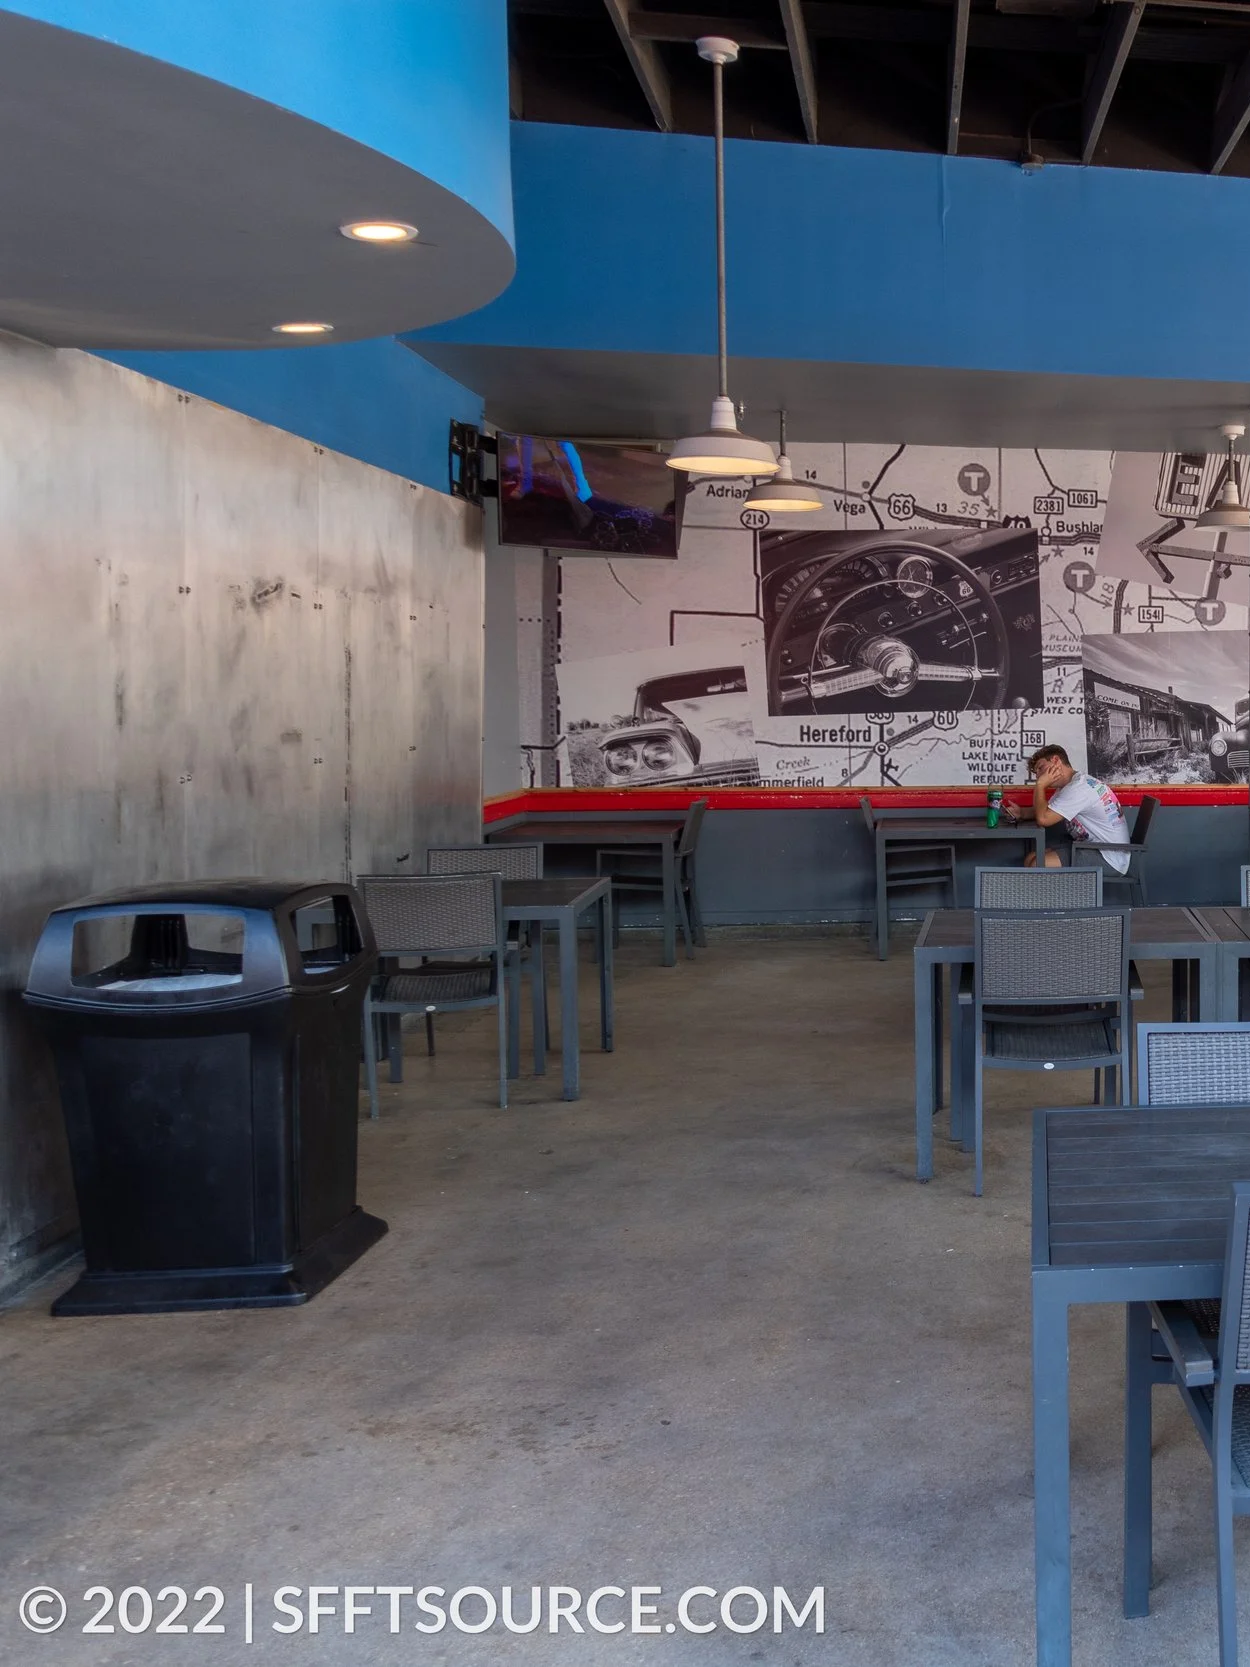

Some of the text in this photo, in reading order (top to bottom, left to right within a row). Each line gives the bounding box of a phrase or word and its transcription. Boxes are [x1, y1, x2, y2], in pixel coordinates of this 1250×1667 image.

[805, 470, 817, 480] 14
[964, 472, 984, 492] T
[1072, 493, 1094, 504] 1061
[834, 500, 866, 515] Vega
[893, 500, 910, 515] 66
[936, 503, 948, 513] 13
[957, 501, 980, 516] 35
[1036, 500, 1061, 512] 2381
[745, 514, 764, 525] 214
[1083, 546, 1094, 556] 14
[1071, 569, 1090, 588] T
[1057, 667, 1067, 677] 11
[1046, 696, 1074, 704] WEST
[1034, 707, 1065, 715] STATE
[907, 714, 918, 724] 14
[937, 710, 954, 725] 60
[799, 724, 871, 743] Hereford
[1024, 732, 1042, 744] 168
[969, 739, 1018, 748] BUFFALO
[962, 752, 1022, 762] LAKE NAT'L
[775, 756, 811, 771] Creek
[968, 763, 1017, 773] WILDLIFE
[972, 775, 1014, 785] REFUGE
